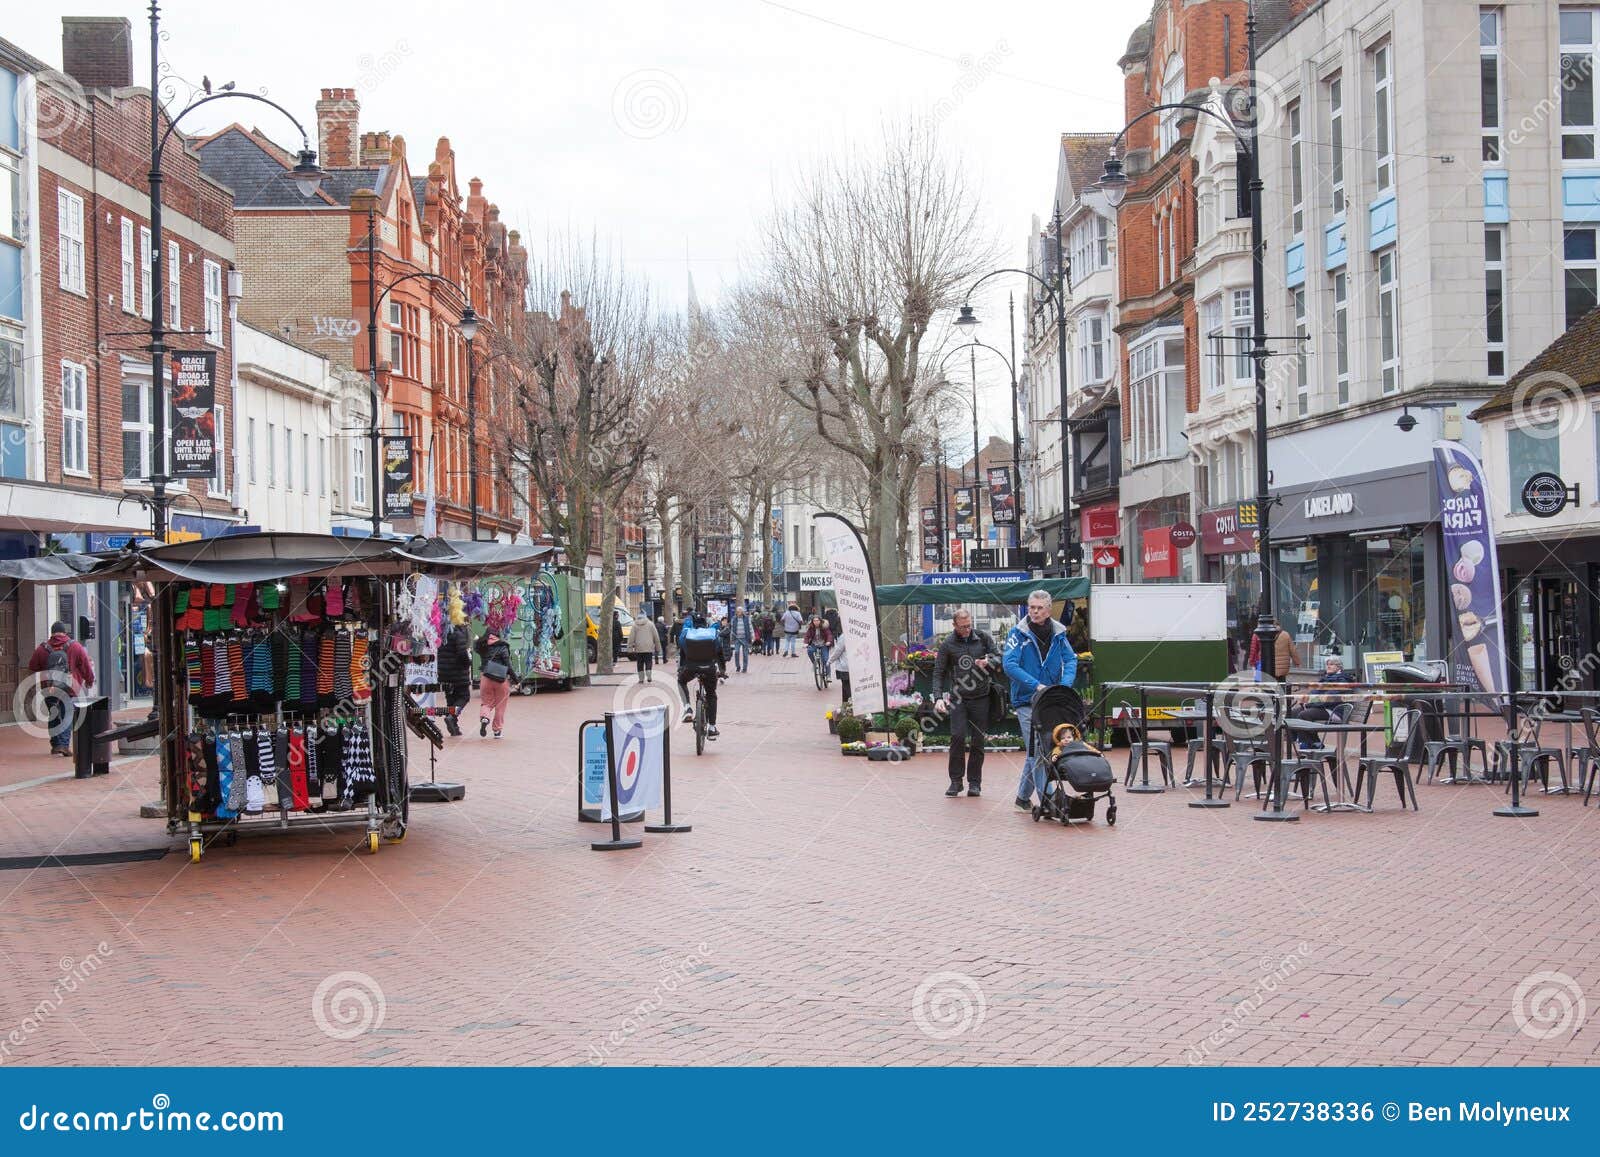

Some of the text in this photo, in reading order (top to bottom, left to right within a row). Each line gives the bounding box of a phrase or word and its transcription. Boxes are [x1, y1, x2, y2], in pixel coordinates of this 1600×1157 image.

[196, 439, 211, 447] LATE
[174, 446, 212, 454] UNTIL 11PM
[176, 453, 210, 461] EVERYDAY
[1304, 492, 1353, 518] LAKELAND
[1216, 515, 1235, 534] COSTA
[801, 576, 821, 587] MARKS
[822, 576, 826, 587] &
